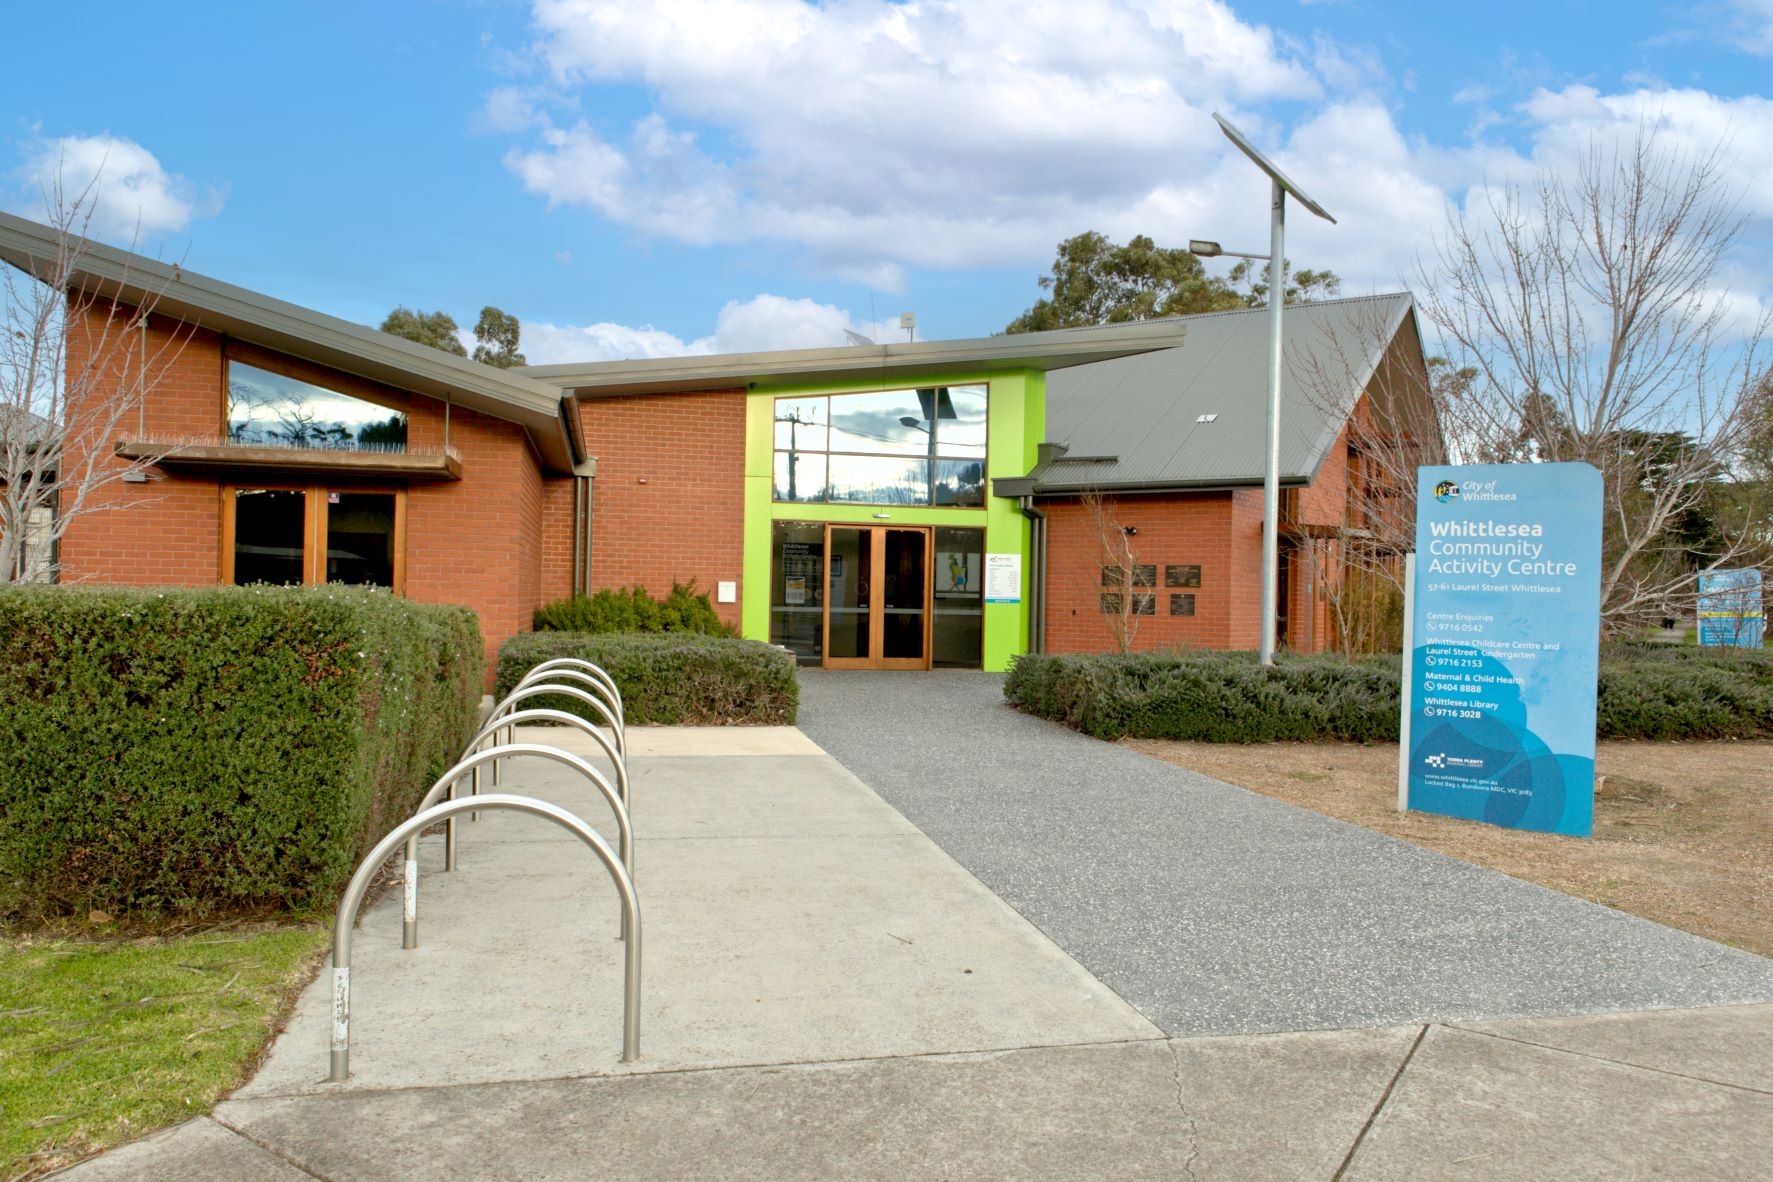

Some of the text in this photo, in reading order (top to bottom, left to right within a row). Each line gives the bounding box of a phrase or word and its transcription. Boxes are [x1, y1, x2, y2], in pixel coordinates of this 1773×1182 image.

[1463, 480, 1497, 491] City of
[1463, 493, 1517, 501] Whittlesea
[1430, 520, 1543, 536] Whittlesea
[1430, 540, 1543, 559] Community
[1428, 559, 1576, 577] Activity Centre
[1428, 584, 1450, 592] 57-61
[1481, 584, 1508, 592] Street
[1512, 585, 1561, 593] Whittlesea
[1456, 613, 1493, 622] Enquiries
[1439, 623, 1483, 632] 9716 0542
[1426, 638, 1560, 651] Whittlesea Childcare Centre and
[1426, 647, 1451, 655] Laurel
[1453, 648, 1477, 656] Street
[1438, 658, 1483, 667] 9716 2153
[1425, 672, 1462, 681] Maternal
[1473, 674, 1495, 682] Child
[1497, 676, 1524, 684] Health
[1437, 683, 1481, 693] 9404 8888
[1425, 697, 1498, 710] Whittlesea Library
[1437, 709, 1481, 719] 9716 3028
[1425, 774, 1498, 785] www.whittlesea.vic.gov.au
[1425, 779, 1443, 787] Locked
[1445, 781, 1456, 789] Bag
